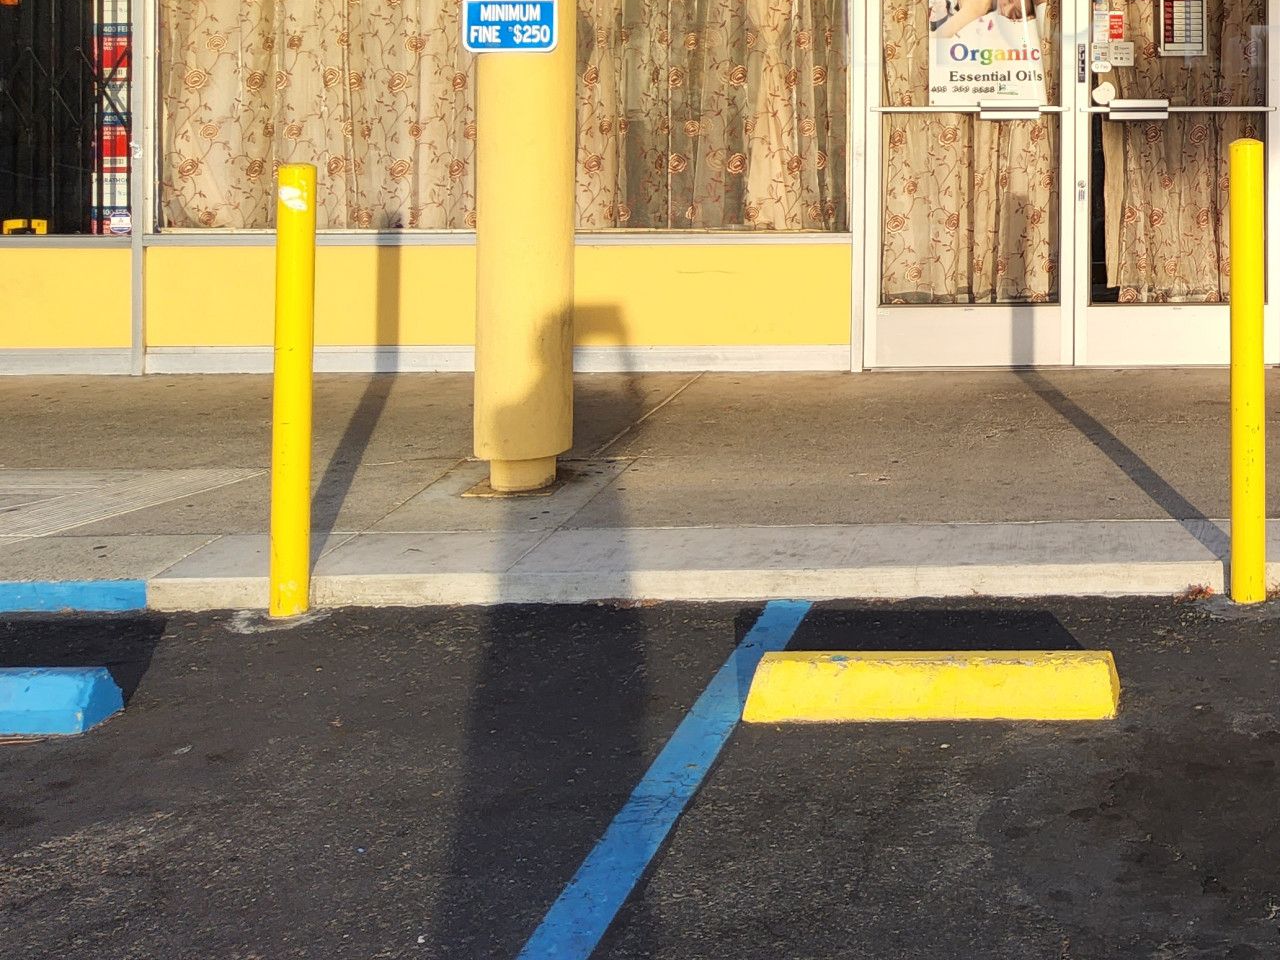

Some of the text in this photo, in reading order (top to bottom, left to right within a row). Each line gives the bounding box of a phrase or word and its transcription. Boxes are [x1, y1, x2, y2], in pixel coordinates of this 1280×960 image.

[480, 3, 541, 22] MINIMUM
[470, 24, 551, 45] FINE $250
[949, 43, 1040, 66] Organic
[949, 70, 1043, 82] Essential Oils
